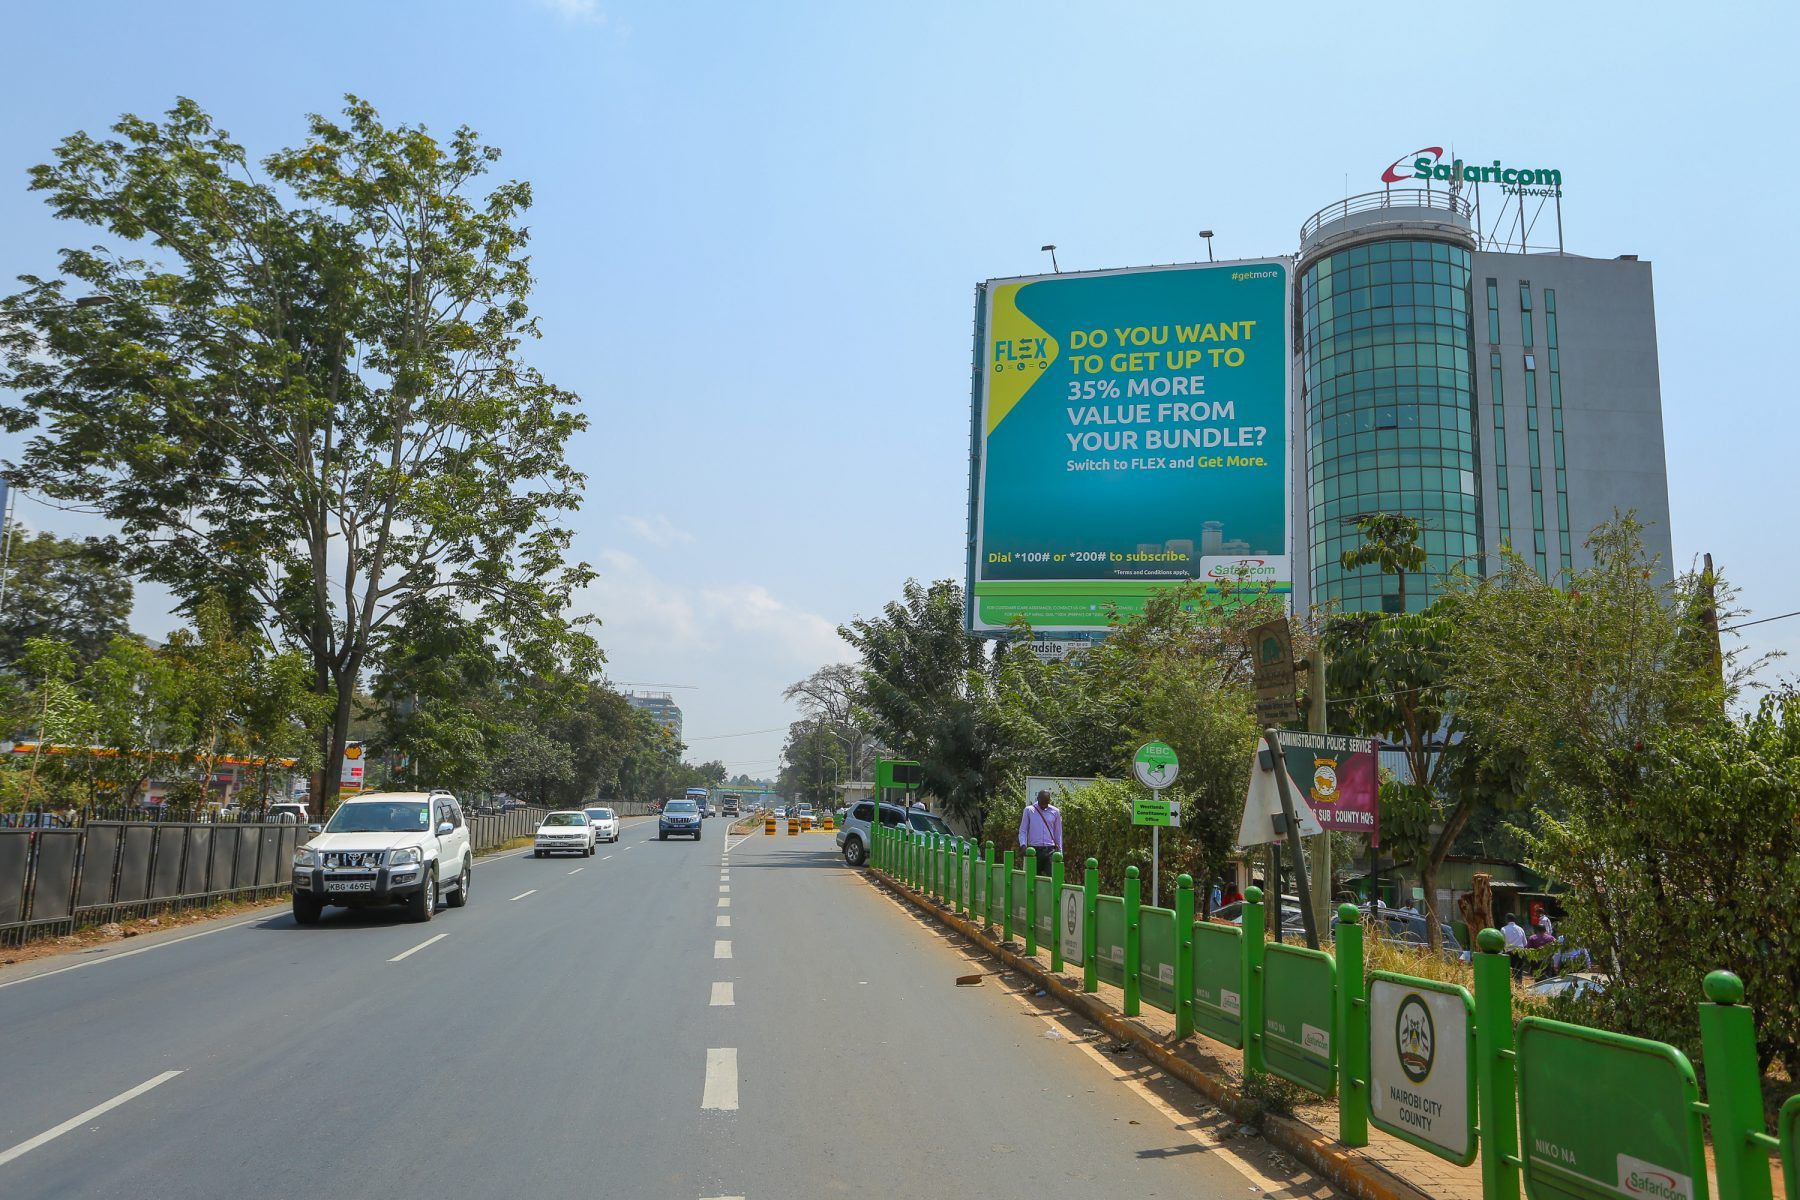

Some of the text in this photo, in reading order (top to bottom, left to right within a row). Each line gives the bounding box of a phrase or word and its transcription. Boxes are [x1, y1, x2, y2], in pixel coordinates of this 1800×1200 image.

[1500, 184, 1562, 198] Twaweza
[1231, 269, 1278, 281] #getmore
[1070, 320, 1257, 350] DO YOU WANT
[994, 337, 1048, 362] FLEX
[1068, 347, 1245, 375] TO GET UP TO
[1067, 375, 1205, 401] 35% MORE
[1066, 400, 1235, 426] VALUE FROM
[1065, 426, 1268, 452] YOUR BUNDLE?
[1066, 455, 1268, 472] Switch to FLEX and Get More.
[988, 552, 1012, 563] Dial
[1053, 554, 1067, 562] or
[1109, 552, 1122, 561] to
[1126, 550, 1190, 562] subscribe.
[1214, 564, 1276, 576] Safacom
[1146, 746, 1170, 755] IEBC
[1279, 731, 1372, 754] ADMINISTRATION POLICE SERVICE
[1318, 809, 1331, 822] SUB
[1335, 810, 1359, 825] COUNTY
[349, 882, 370, 890] 469E
[1390, 1086, 1442, 1117] NAIROBI CITY
[1399, 1107, 1432, 1131] COUNTY
[1535, 1139, 1577, 1165] NIKO NA
[1630, 1171, 1690, 1200] Safaricom
